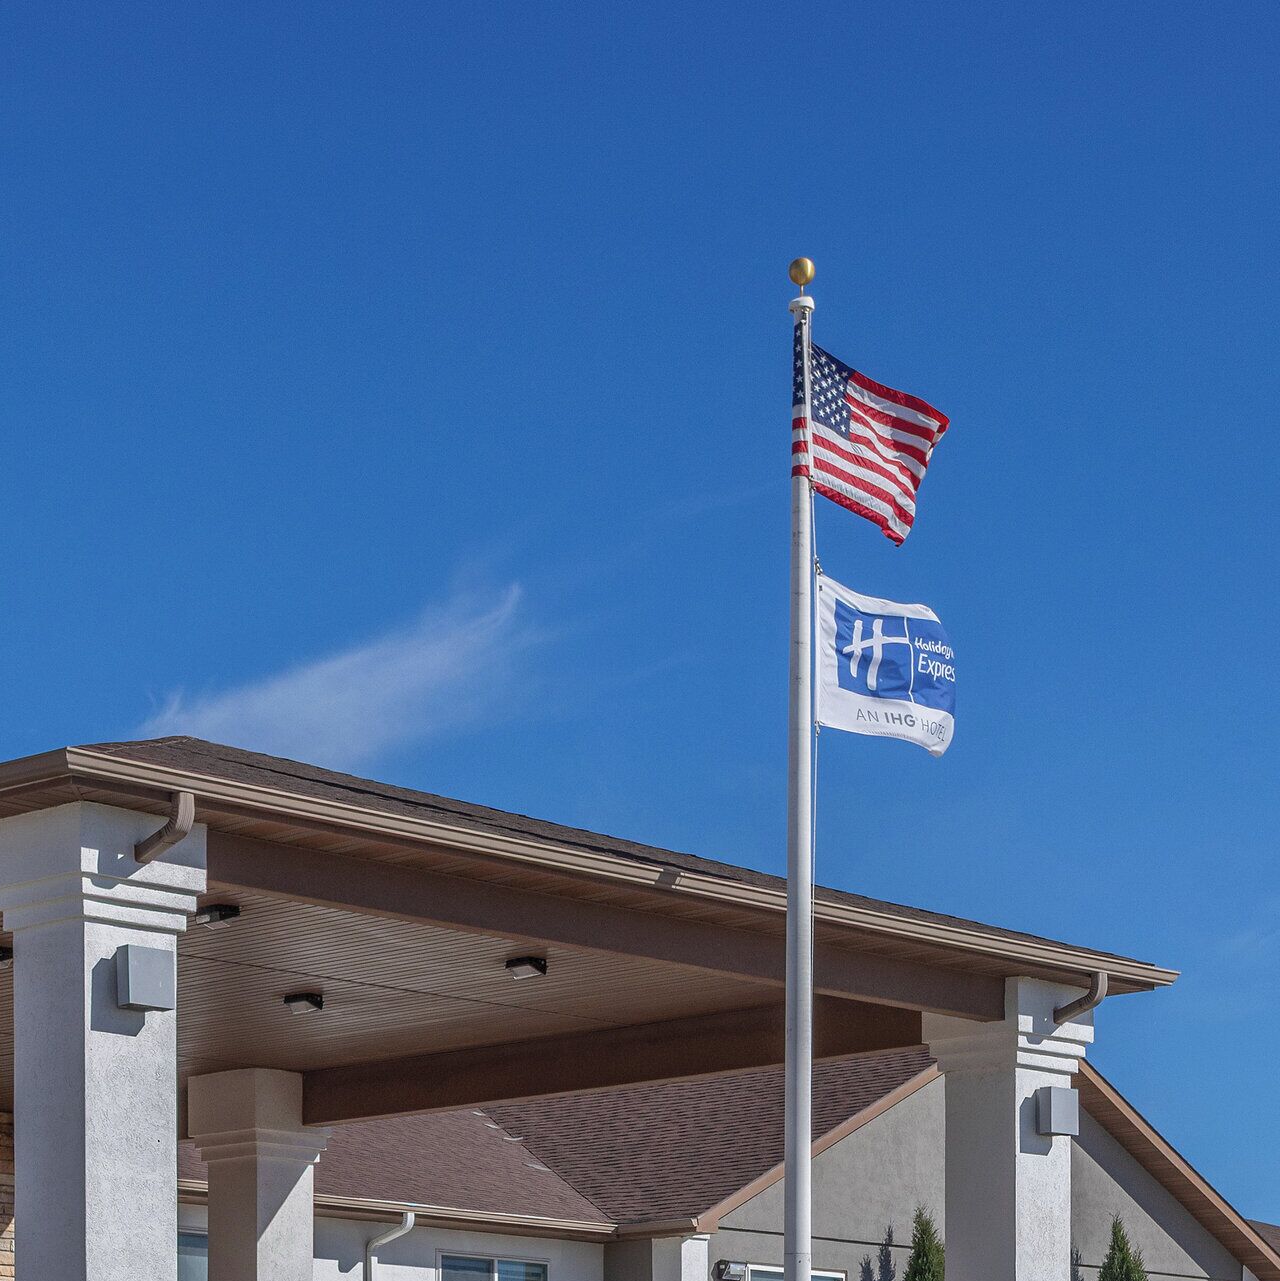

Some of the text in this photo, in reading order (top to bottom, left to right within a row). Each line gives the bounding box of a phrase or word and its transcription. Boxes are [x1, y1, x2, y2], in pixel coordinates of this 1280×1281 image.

[914, 636, 951, 660] Holiday
[918, 652, 956, 682] Expres
[856, 708, 947, 742] AN IHG HOTEL
